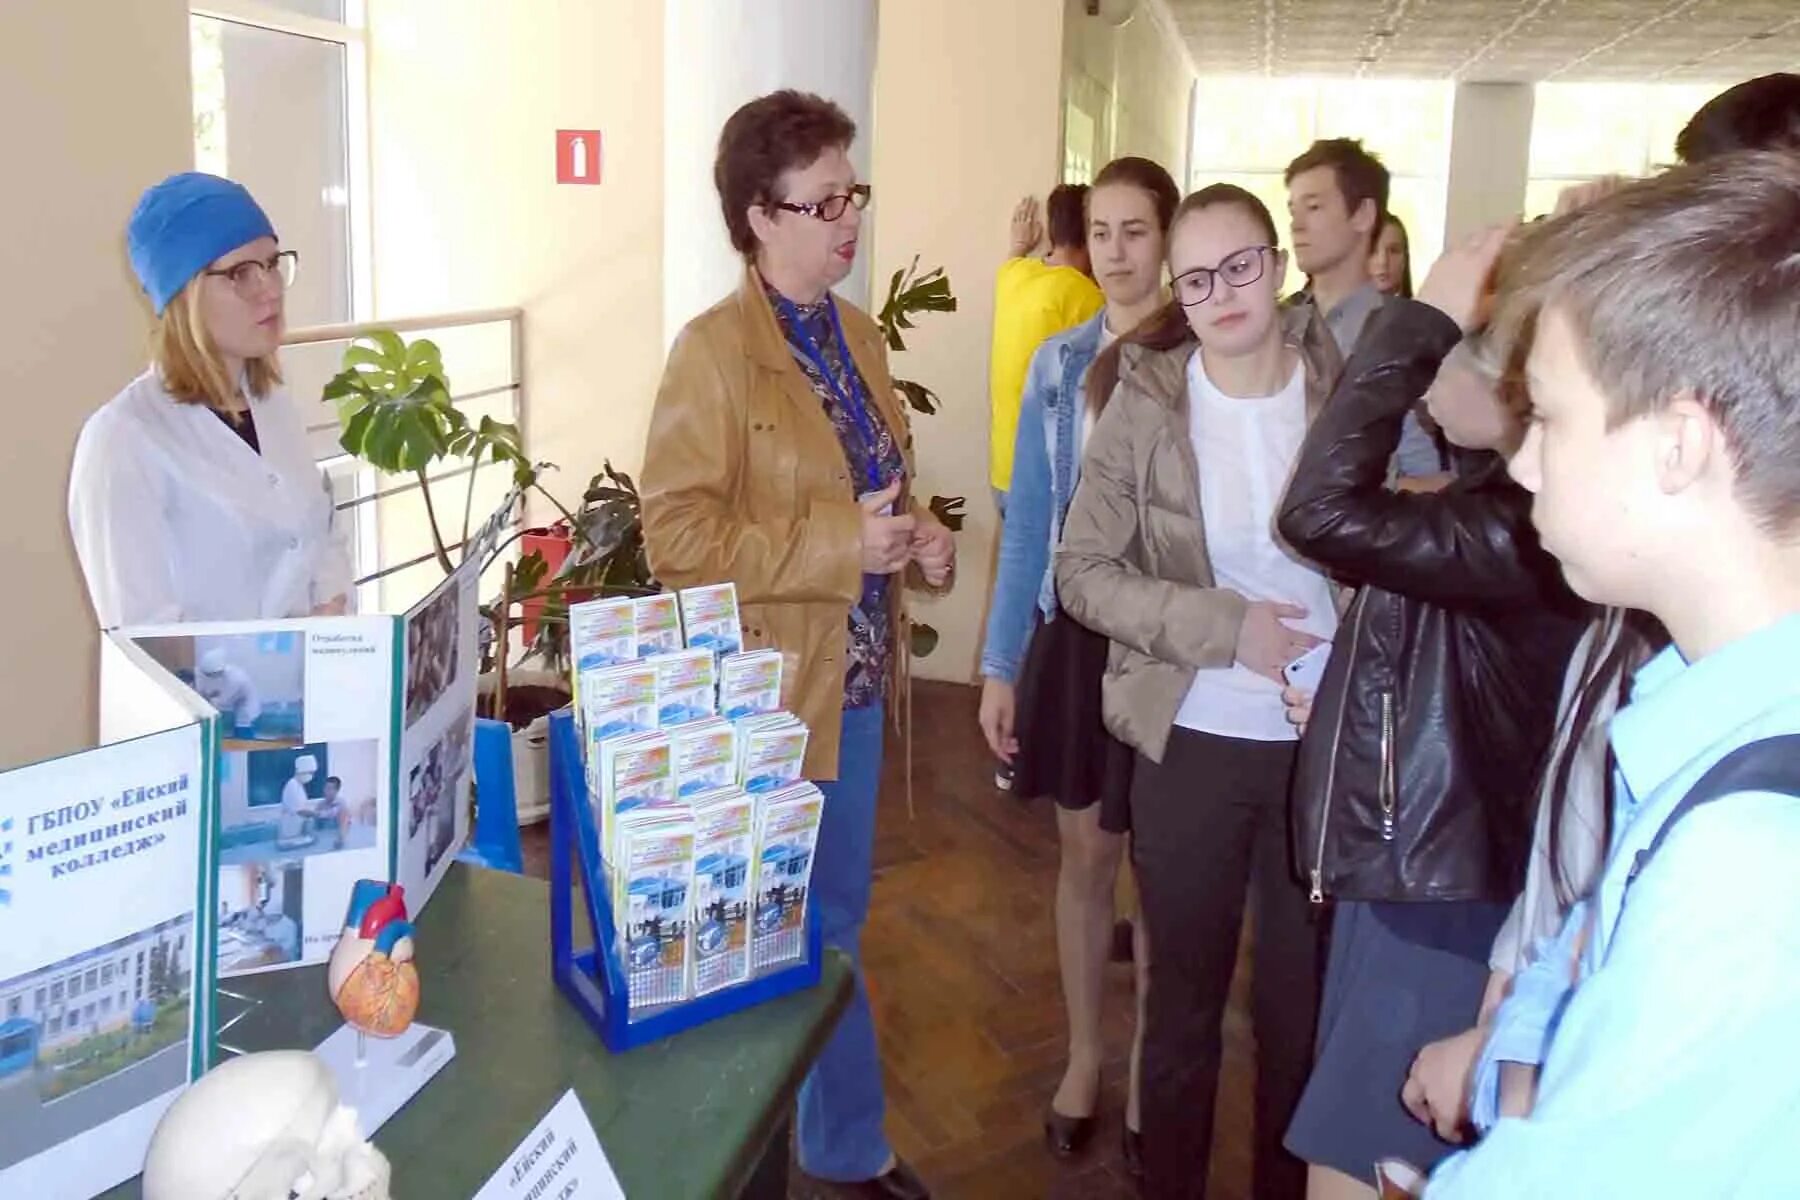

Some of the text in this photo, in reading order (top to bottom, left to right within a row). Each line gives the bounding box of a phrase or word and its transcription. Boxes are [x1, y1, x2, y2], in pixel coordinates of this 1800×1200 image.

[26, 799, 187, 862] медицинский
[27, 773, 189, 835] ГБПОУ «Ейский
[51, 833, 166, 878] колледж»
